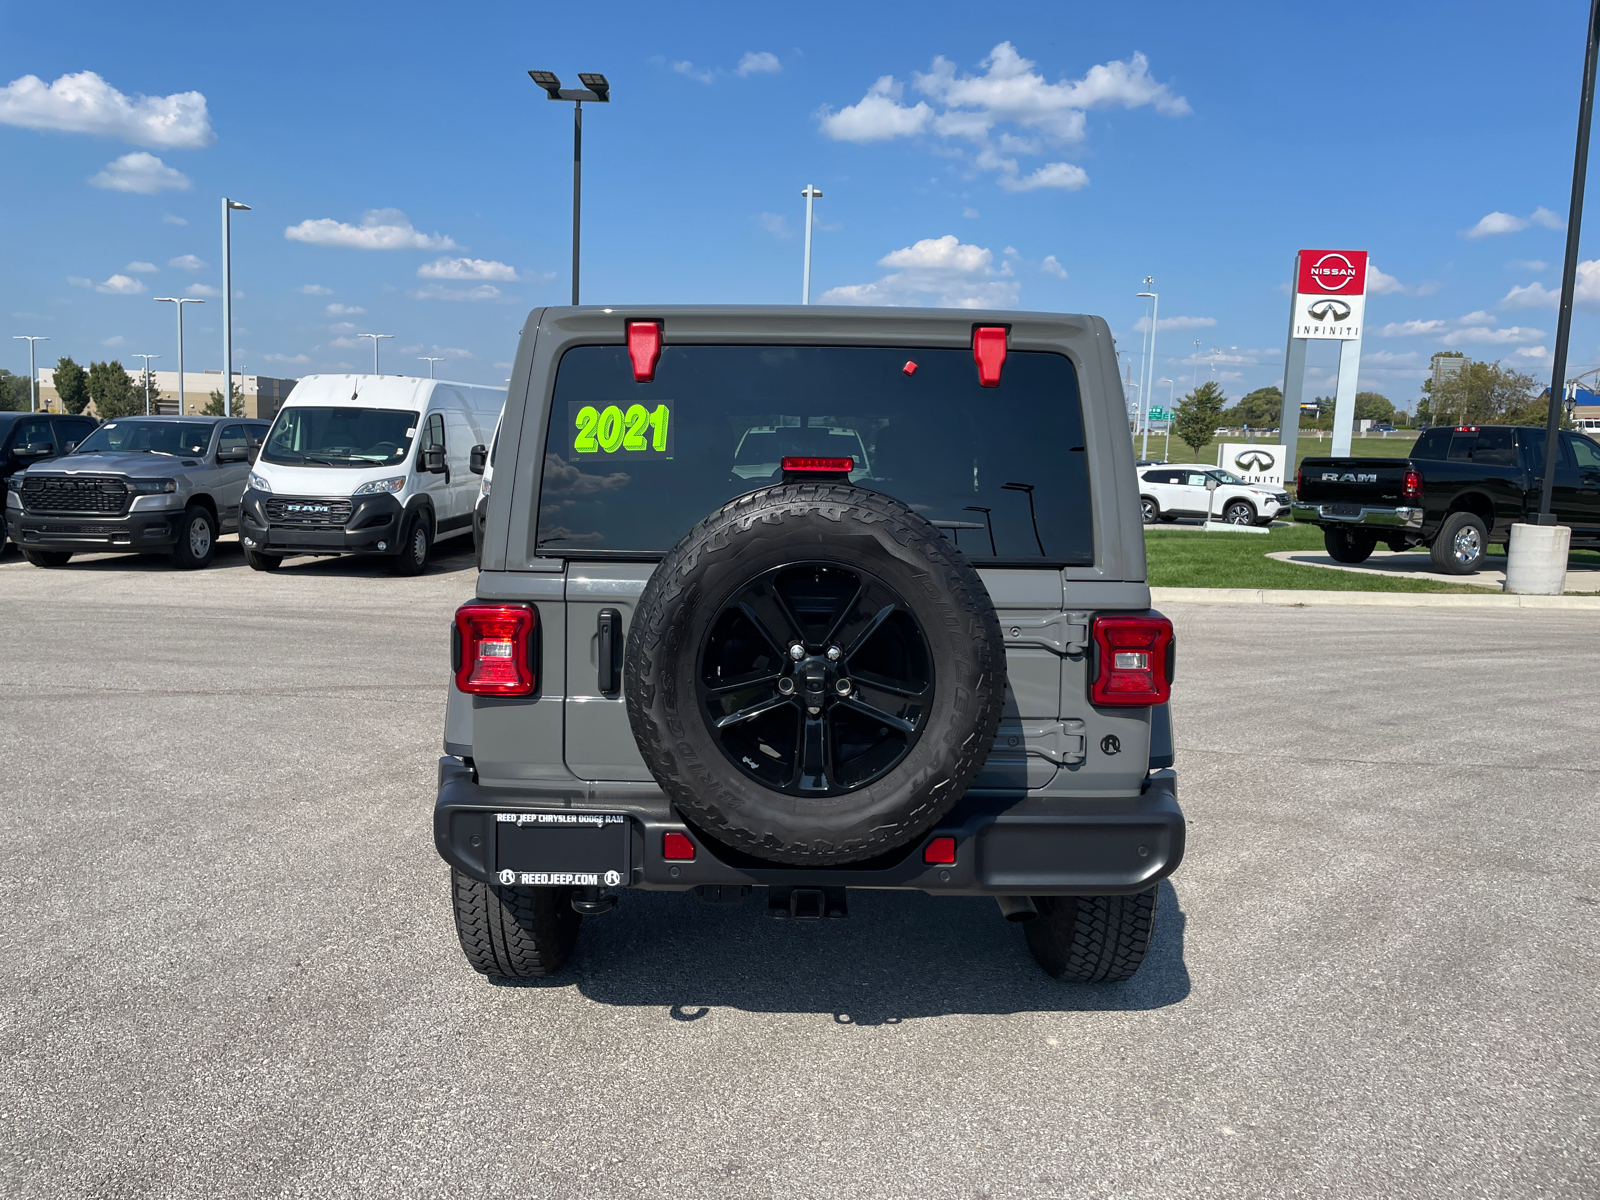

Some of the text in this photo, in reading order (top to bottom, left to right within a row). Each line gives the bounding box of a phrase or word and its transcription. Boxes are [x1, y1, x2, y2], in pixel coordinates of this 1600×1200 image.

[1311, 268, 1355, 276] NISSAN
[1297, 325, 1359, 336] INFINITI
[574, 403, 670, 453] 2021
[1241, 475, 1280, 484] FINITI
[1321, 472, 1377, 483] RAM
[45, 481, 95, 490] RAM
[912, 573, 972, 748] DUELER
[660, 581, 747, 811] BRIDGESTONE
[497, 813, 624, 824] REED JEEP CHRYSLER DODGE RAM
[521, 873, 598, 885] REEDJEEP.COM
